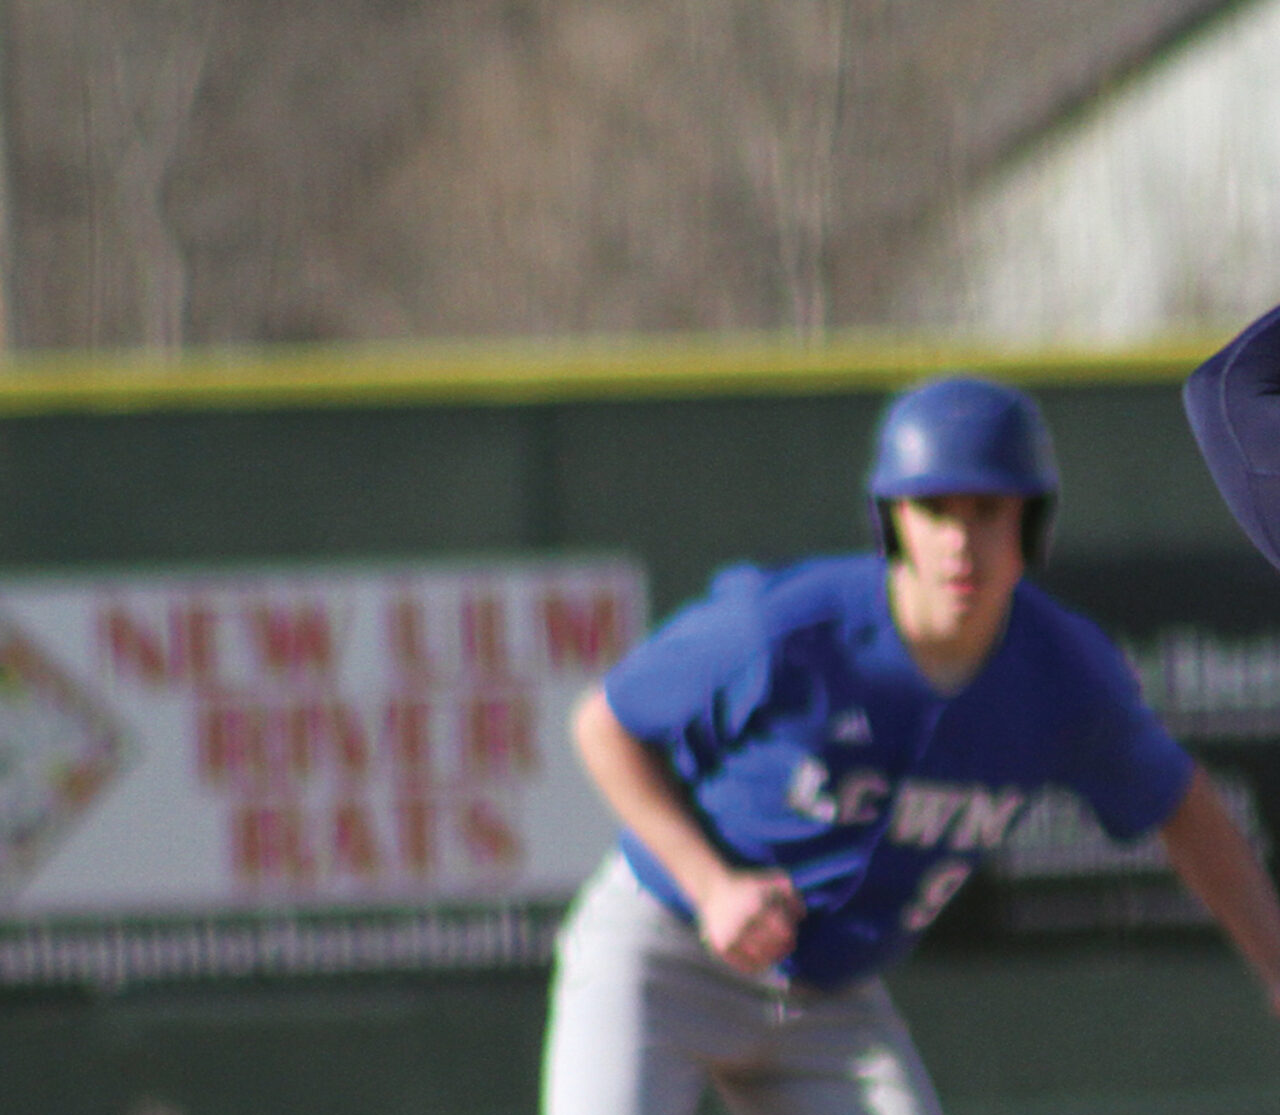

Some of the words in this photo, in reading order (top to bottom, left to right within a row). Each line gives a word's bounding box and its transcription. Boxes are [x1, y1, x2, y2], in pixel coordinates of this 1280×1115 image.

[98, 597, 337, 686] NEW
[202, 694, 537, 775] RIVER
[235, 800, 523, 877] RATS
